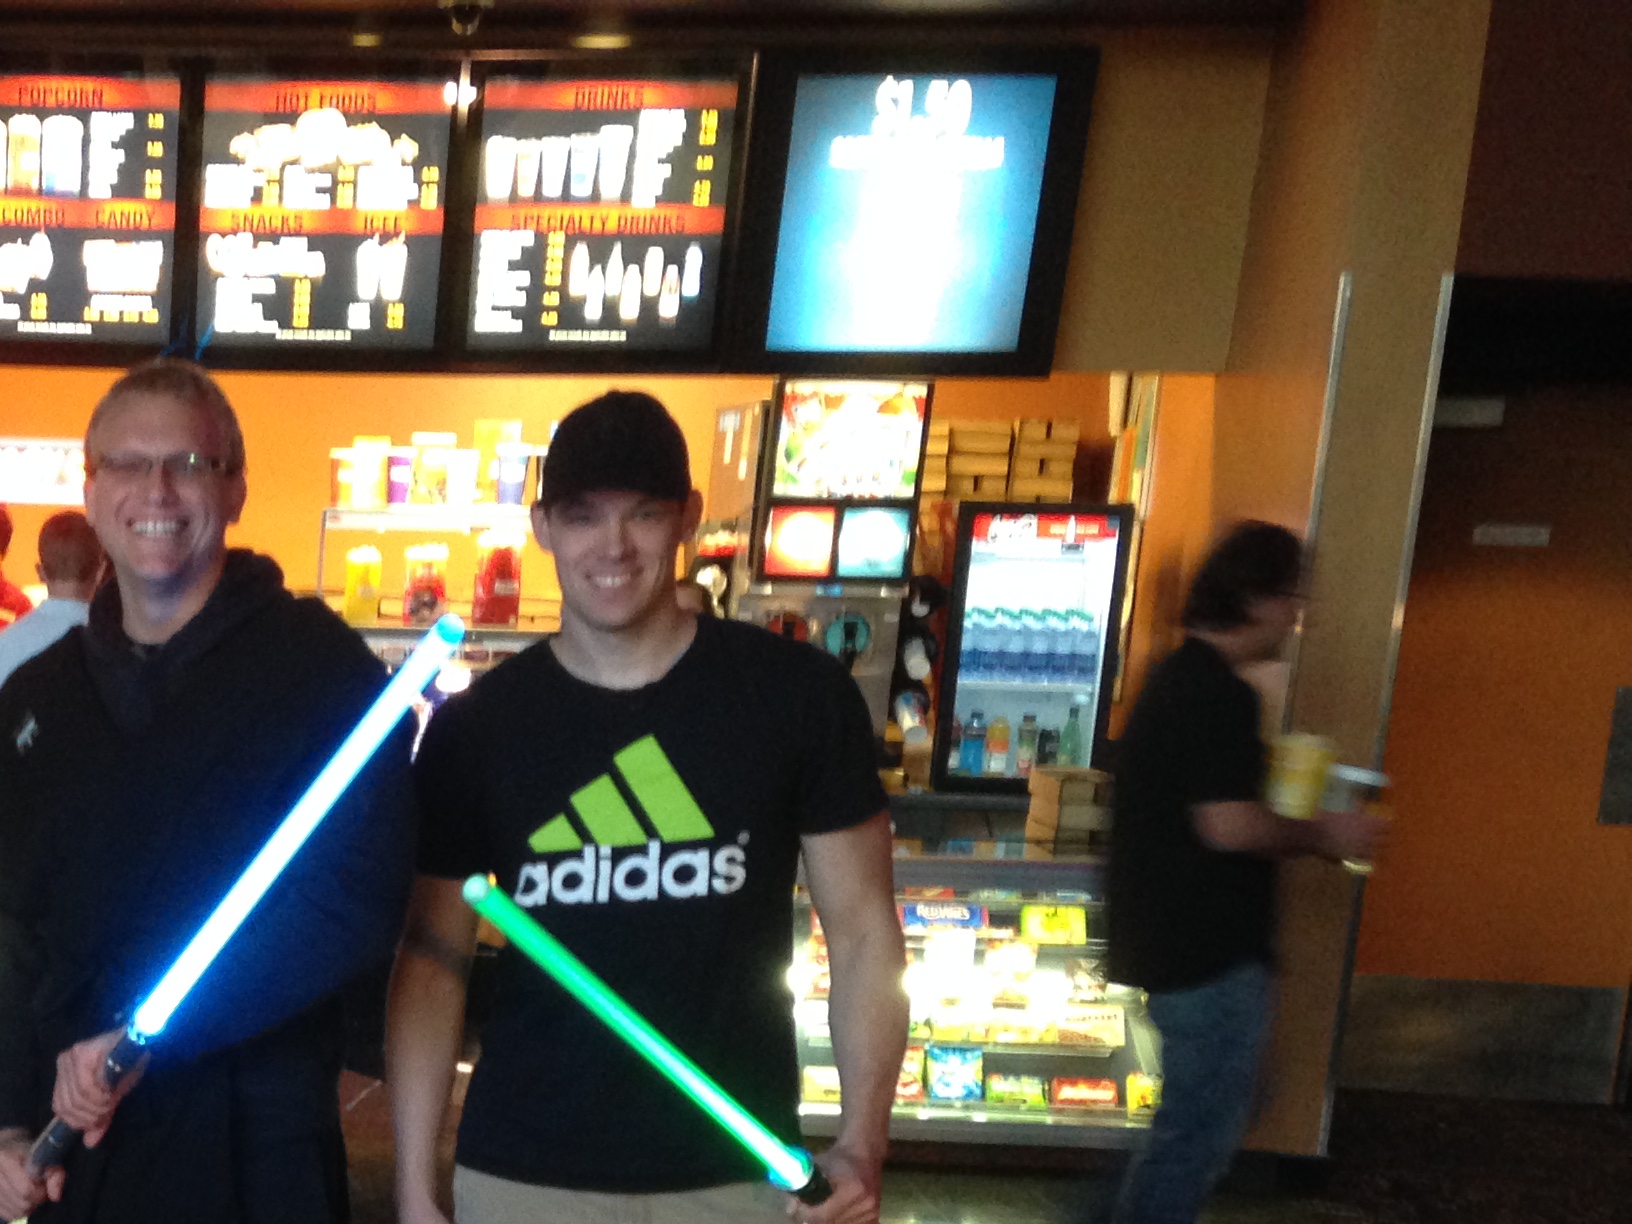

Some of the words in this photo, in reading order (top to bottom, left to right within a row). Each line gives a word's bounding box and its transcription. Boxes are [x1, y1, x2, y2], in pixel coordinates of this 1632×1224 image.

[18, 84, 104, 108] POPCORN
[275, 90, 308, 114] HOT
[574, 86, 644, 110] DRINKS
[94, 206, 157, 230] CANDY
[229, 210, 305, 234] SNACKS
[514, 838, 748, 908] adidas
